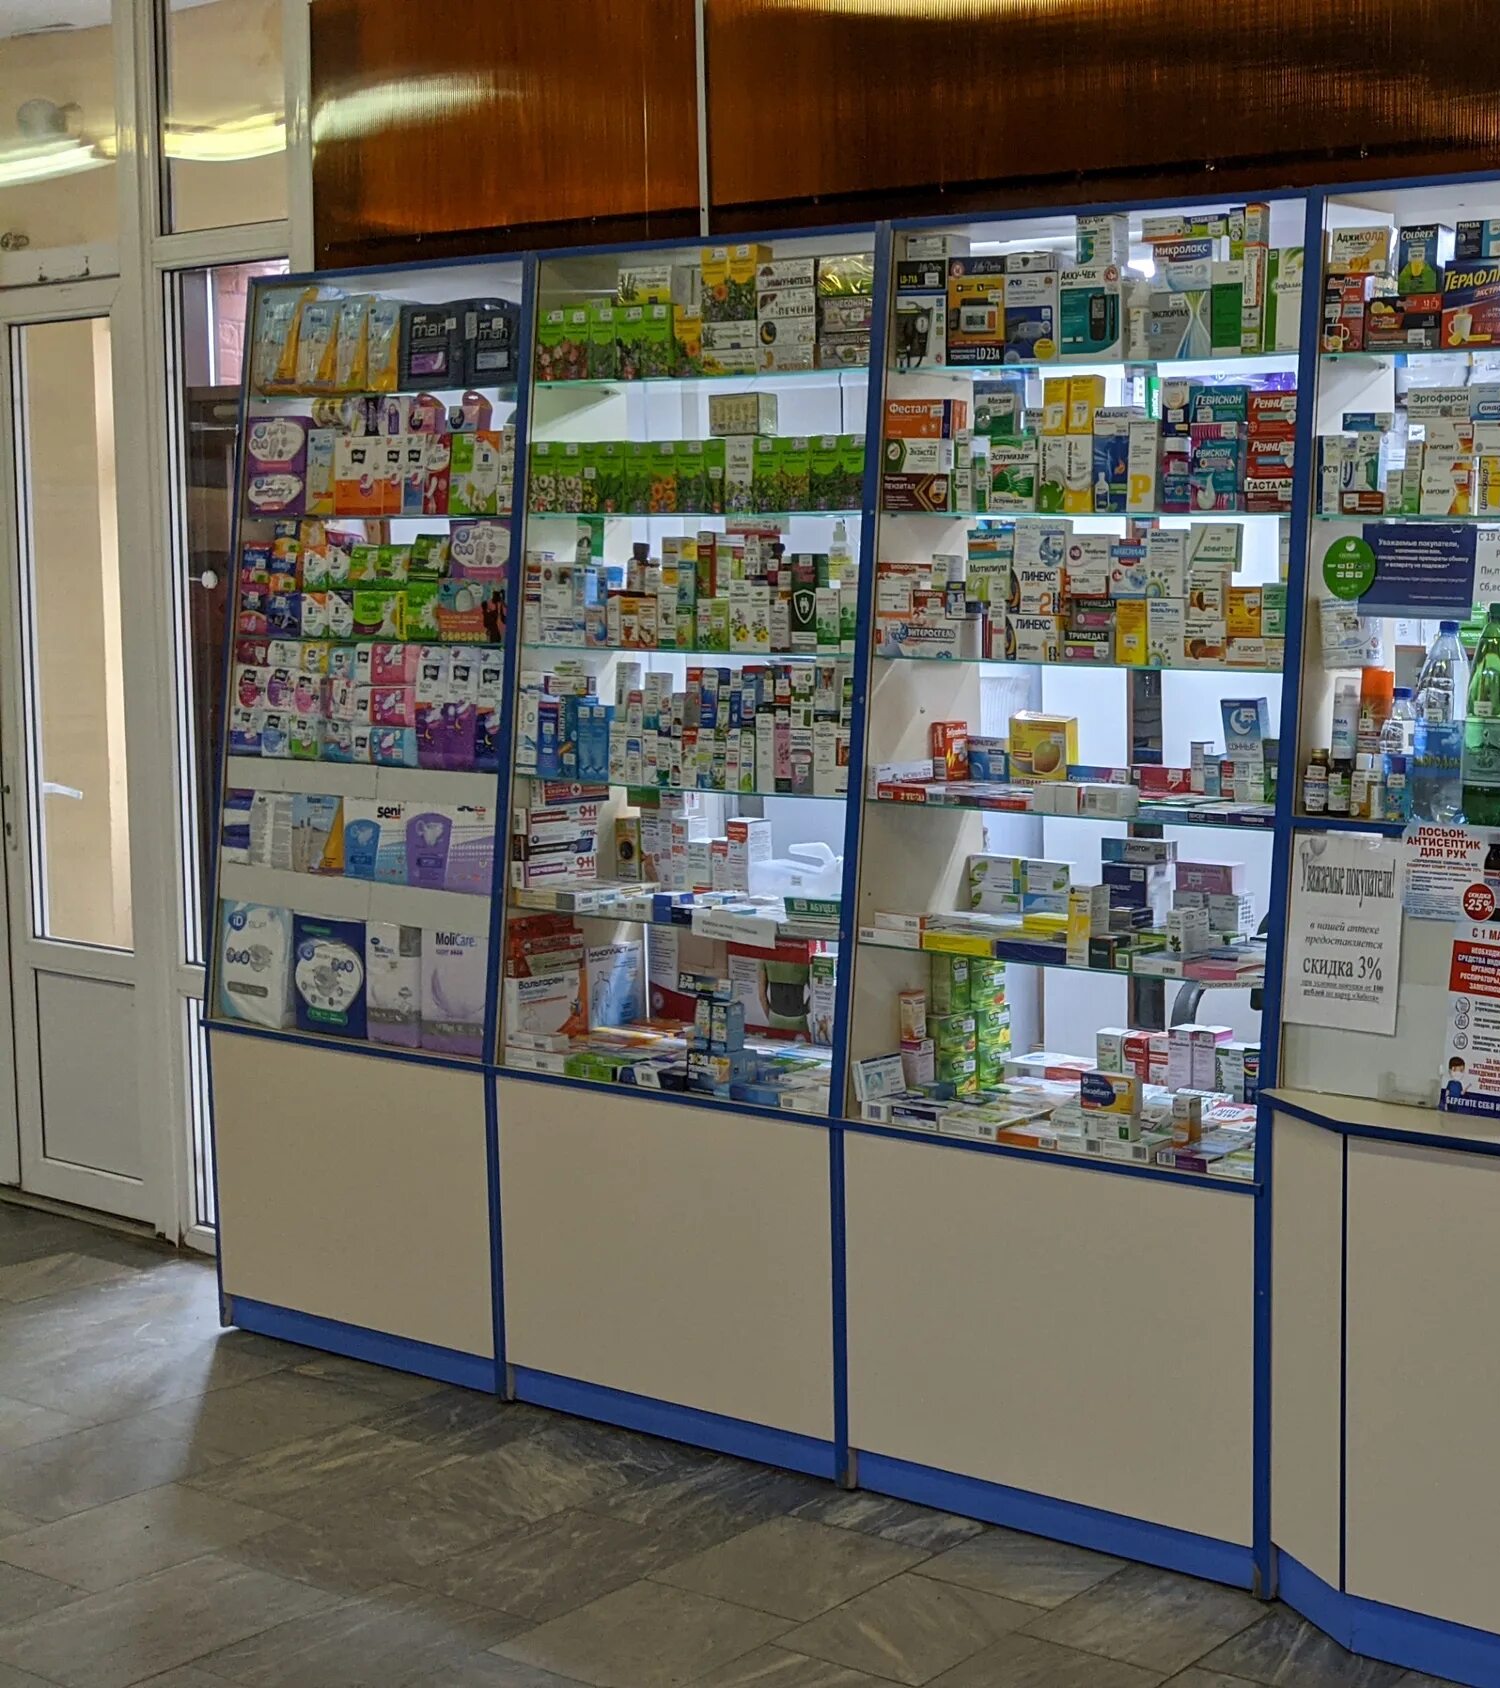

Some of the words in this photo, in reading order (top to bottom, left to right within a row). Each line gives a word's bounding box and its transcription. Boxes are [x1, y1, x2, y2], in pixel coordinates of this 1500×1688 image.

[1401, 230, 1434, 240] COLDREX
[1413, 393, 1469, 404] Эргоферон
[889, 403, 928, 414] Фестал
[1095, 410, 1128, 419] Маалокс
[991, 453, 1030, 462] Эспумизан
[970, 564, 1007, 574] Мотилиум
[1021, 571, 1056, 582] ЛИНЕКС
[1016, 620, 1052, 630] ЛИНЕКС
[908, 628, 956, 639] ЭНТЕРОСГЕЛЬ
[1068, 632, 1105, 640] ТРИМЕДАТ
[377, 804, 401, 818] seni
[1418, 827, 1468, 838] ЛОСЬОН-
[1407, 836, 1480, 850] АНТИСЕПТИК
[1420, 848, 1442, 857] ДЛЯ
[1447, 850, 1466, 859] РУК
[1301, 852, 1344, 895] Уважаемые
[1346, 859, 1396, 908] покупатели!
[1465, 900, 1493, 912] -25%
[1317, 922, 1346, 932] нашей
[1347, 926, 1380, 934] аптеке
[1472, 928, 1478, 937] С
[1482, 930, 1485, 938] 1
[436, 932, 476, 947] MoliCare
[1305, 936, 1382, 950] предоставляется
[1458, 954, 1486, 964] СРЕДСТВА
[1303, 958, 1353, 980] скидка
[1358, 956, 1382, 980] 3%
[518, 977, 564, 990] Вольтарен
[1446, 1096, 1477, 1108] БЕРЕГИТЕ
[1478, 1100, 1495, 1110] СЕБЯ
